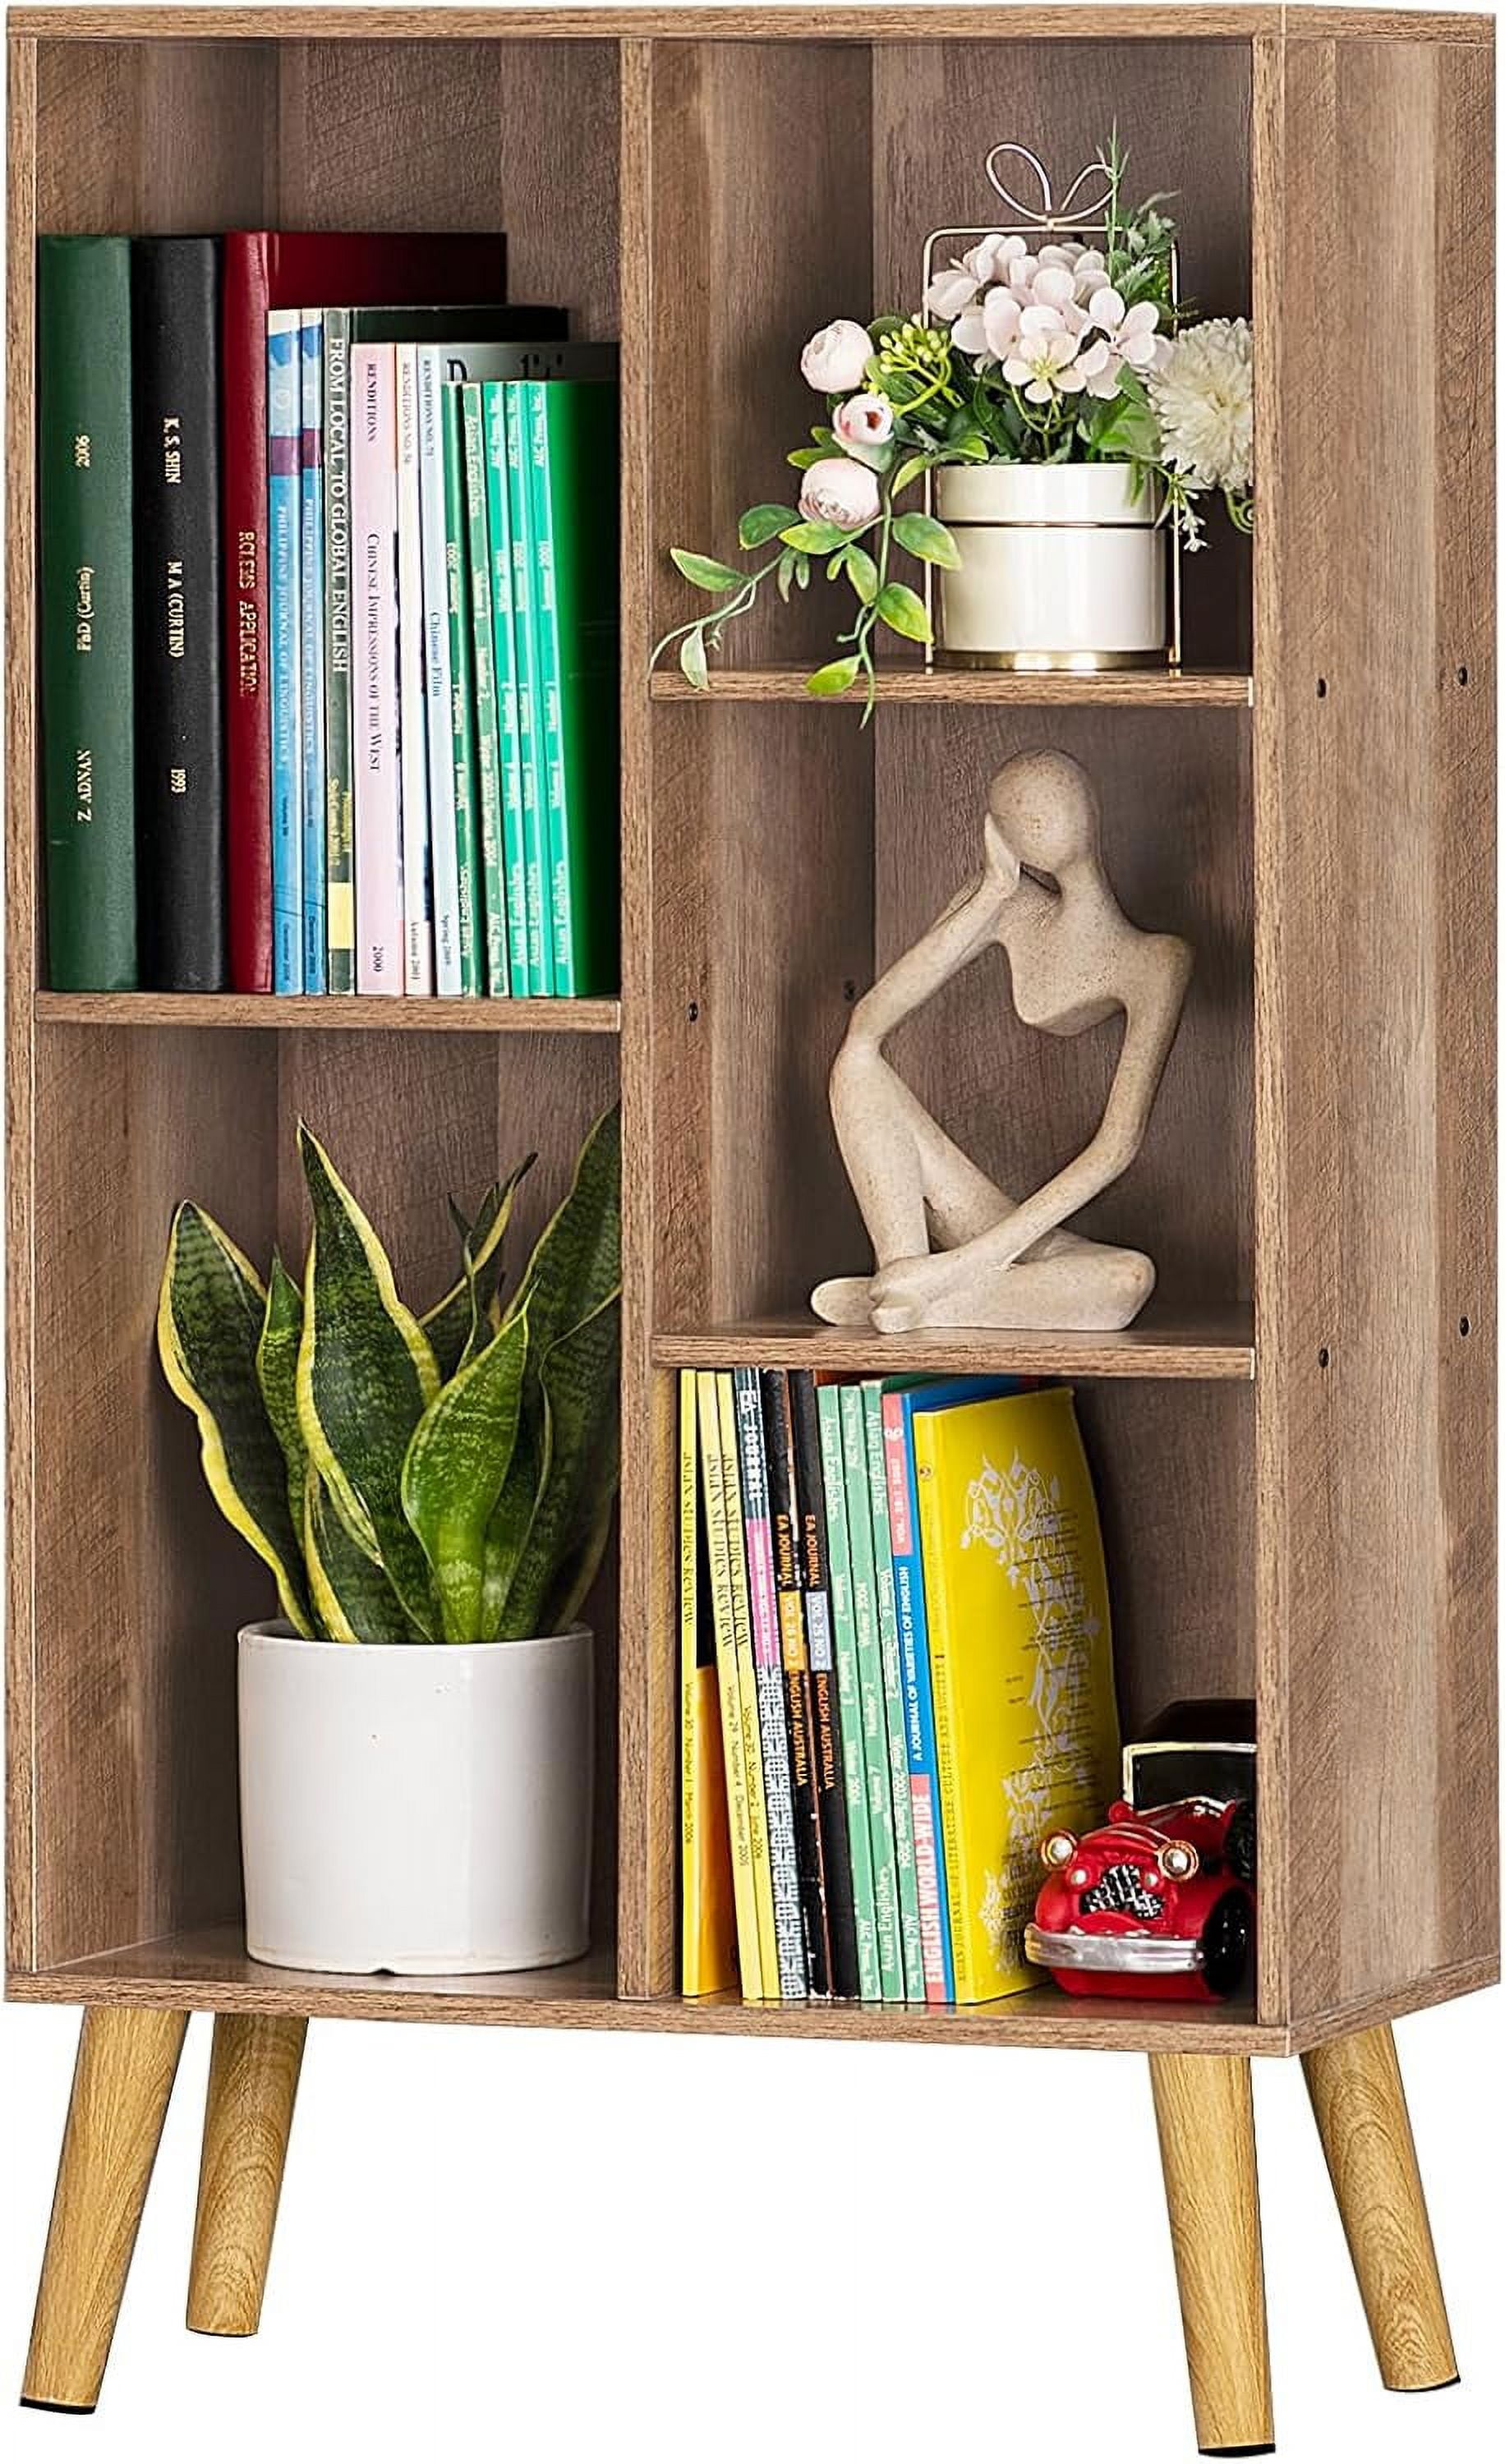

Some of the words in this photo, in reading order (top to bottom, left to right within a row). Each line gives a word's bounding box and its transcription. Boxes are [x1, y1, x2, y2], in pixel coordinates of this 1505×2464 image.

[328, 338, 346, 393] FROM
[366, 363, 378, 442] RENDITIONS
[76, 434, 91, 468] 2006
[329, 399, 347, 465] LOCAL
[164, 451, 181, 485] SHIN
[329, 471, 347, 499] TO
[330, 503, 348, 585] GLOBAL
[366, 533, 381, 591] CHINESE
[167, 562, 182, 575] M
[167, 577, 182, 590] A
[165, 593, 184, 658] (CURTIN)
[277, 585, 289, 647] JOURNAL
[302, 577, 315, 641] JOURNAL
[331, 589, 349, 673] ENGLISH
[278, 651, 289, 669] OF
[304, 645, 315, 664] OF
[367, 595, 382, 682] IMPRESSIONS
[429, 611, 443, 664] Chinese
[368, 684, 380, 701] OF
[430, 668, 444, 696] Film
[368, 706, 380, 730] THE
[76, 748, 92, 803] ADNAN
[369, 733, 382, 774] WEST
[170, 768, 186, 793] 1993
[439, 914, 451, 944] Spring
[555, 926, 568, 965] Asian
[372, 945, 384, 972] 2000
[822, 1416, 837, 1457] Asian
[866, 1410, 880, 1449] Asian
[742, 1423, 763, 1503] JOURNAL
[868, 1451, 885, 1515] Englishes
[824, 1459, 840, 1520] Englishes
[776, 1514, 789, 1529] EA
[804, 1514, 817, 1529] EA
[777, 1533, 792, 1587] JOURNAL
[805, 1533, 820, 1587] JOURNAL
[879, 1568, 891, 1607] Volume
[899, 1566, 912, 1613] ENGLISH
[900, 1615, 912, 1629] OF
[787, 1670, 802, 1718] ENGLISH
[814, 1673, 831, 1722] ENGLISH
[907, 1685, 918, 1699] OF
[909, 1701, 922, 1751] JOURNAL
[789, 1721, 808, 1786] AUSTRALIA
[818, 1724, 835, 1789] AUSTRALIA
[891, 1734, 905, 1771] Winter
[910, 1753, 923, 1762] A
[685, 1791, 694, 1819] March
[733, 1795, 747, 1841] December
[911, 1794, 936, 1906] WORLD-WIDE
[876, 1865, 893, 1932] Englishes
[879, 1933, 895, 1973] Asian
[917, 1908, 942, 1984] ENGLISH
